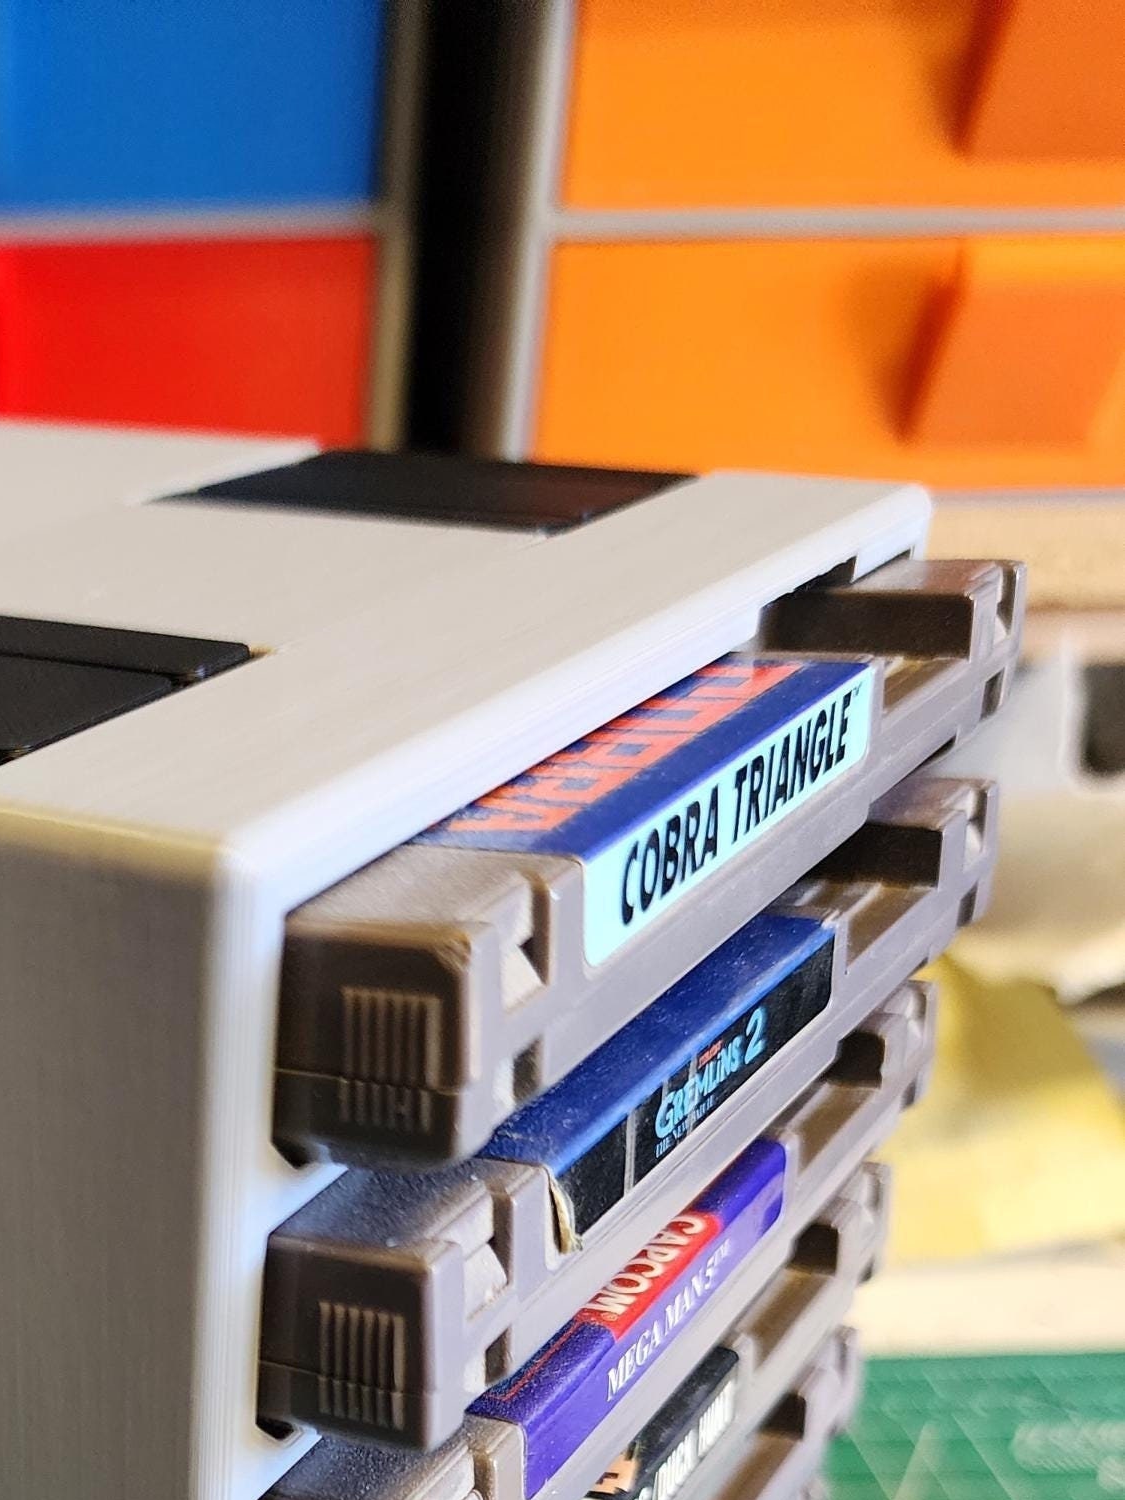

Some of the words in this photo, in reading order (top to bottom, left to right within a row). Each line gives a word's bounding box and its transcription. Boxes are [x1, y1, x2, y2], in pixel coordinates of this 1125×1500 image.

[621, 783, 719, 926] COBRA
[744, 1005, 766, 1064] 2
[607, 1320, 662, 1402] MEGA
[664, 1270, 703, 1337] MAN
[699, 1380, 735, 1457] HUNT
